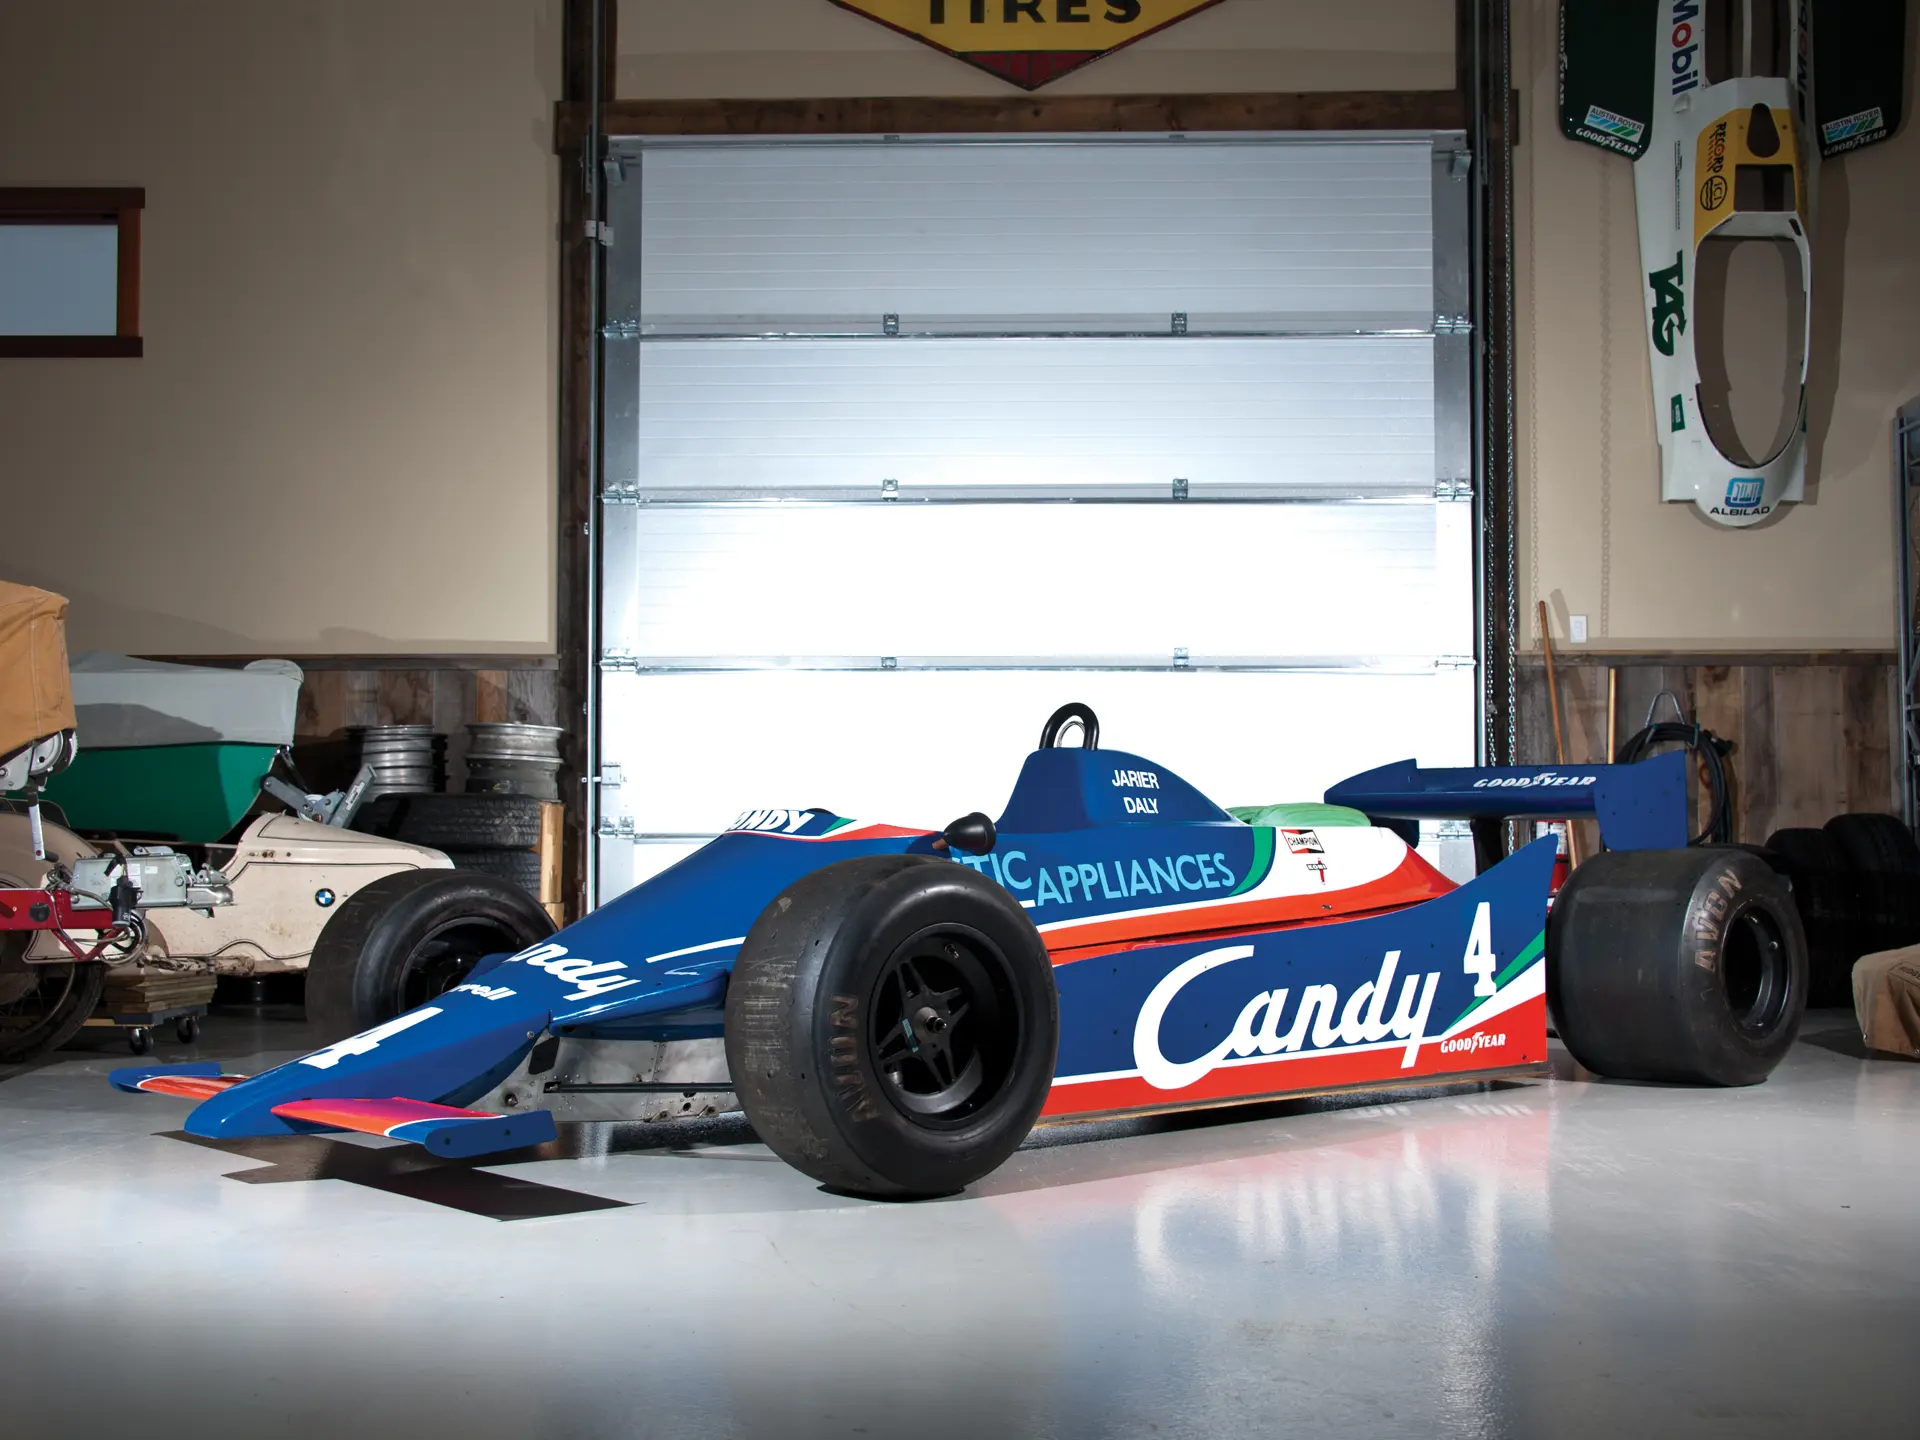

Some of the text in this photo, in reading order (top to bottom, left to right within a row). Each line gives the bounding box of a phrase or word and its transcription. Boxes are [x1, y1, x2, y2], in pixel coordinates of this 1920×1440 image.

[1672, 0, 1698, 95] Mobil
[1591, 108, 1642, 131] AUSTIN ROVER
[1826, 109, 1879, 130] AUSTIN ROVER
[1575, 128, 1638, 155] GOODYEAR
[1710, 122, 1727, 173] RECORD
[1823, 129, 1888, 157] GOODYEAR
[1713, 181, 1722, 200] ICI
[1710, 506, 1770, 516] ALBILAD
[1112, 769, 1159, 789] JARIER
[1473, 772, 1597, 789] GOODYEAR
[1123, 797, 1158, 814] DALY
[1287, 837, 1320, 846] CHAMPION
[952, 850, 1236, 906] TIC APPLIANCES
[1463, 901, 1497, 997] 4
[502, 943, 642, 1001] ndy
[1133, 944, 1441, 1089] Candy
[1440, 1031, 1506, 1054] GOODYEAR
